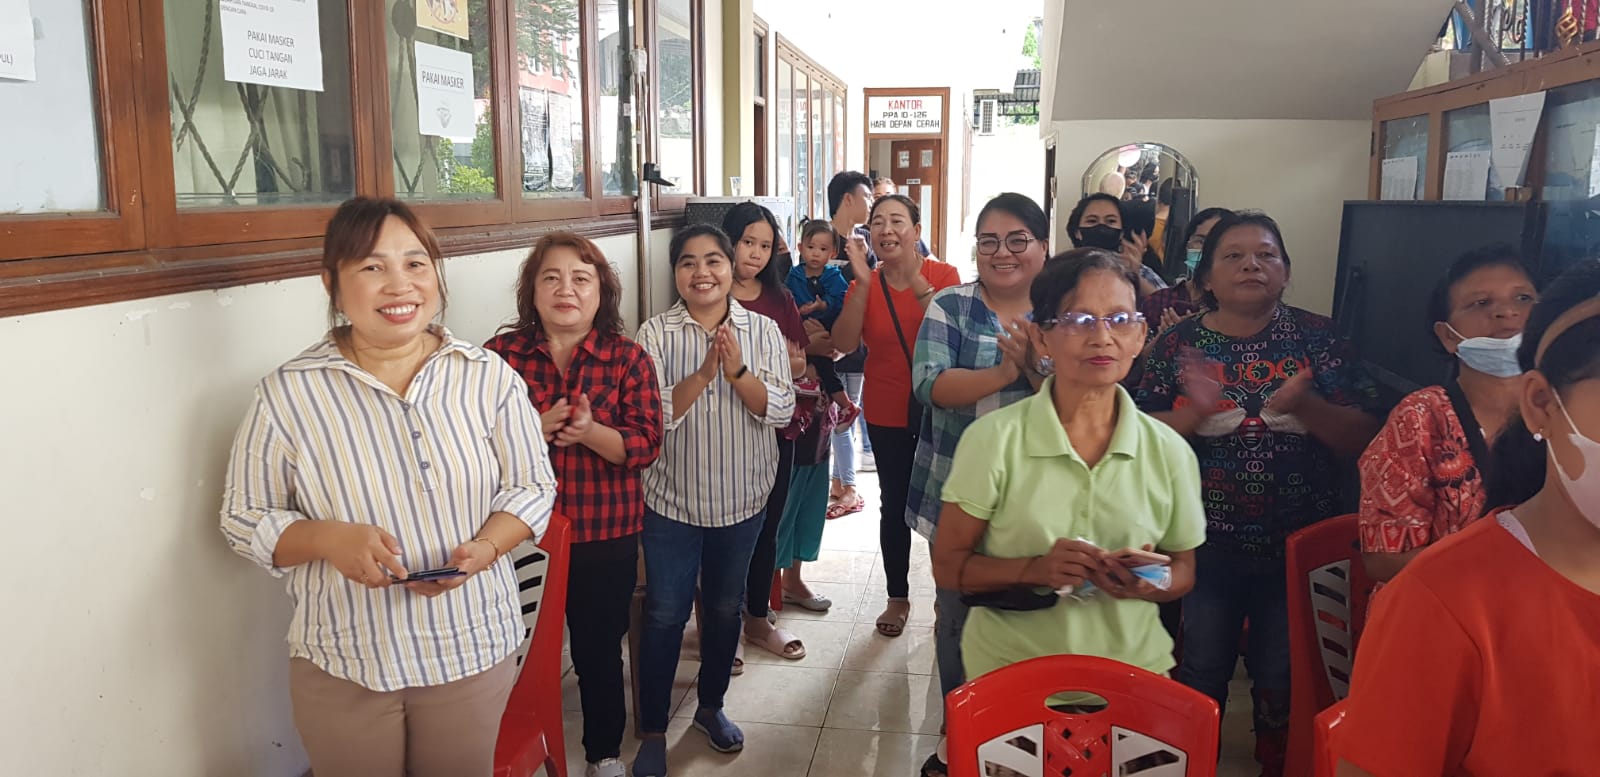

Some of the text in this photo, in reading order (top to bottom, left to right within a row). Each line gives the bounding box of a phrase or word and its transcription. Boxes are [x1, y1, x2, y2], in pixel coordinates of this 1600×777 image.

[247, 30, 295, 48] PAKAI MASKER
[248, 47, 293, 64] CUCI TANGAN
[249, 65, 288, 79] JAGA JARAK
[422, 70, 464, 89] PAKAI MASKER
[888, 99, 923, 110] KANTOR
[882, 111, 899, 119] PPA
[870, 119, 940, 129] HARI DEPAN CERAH
